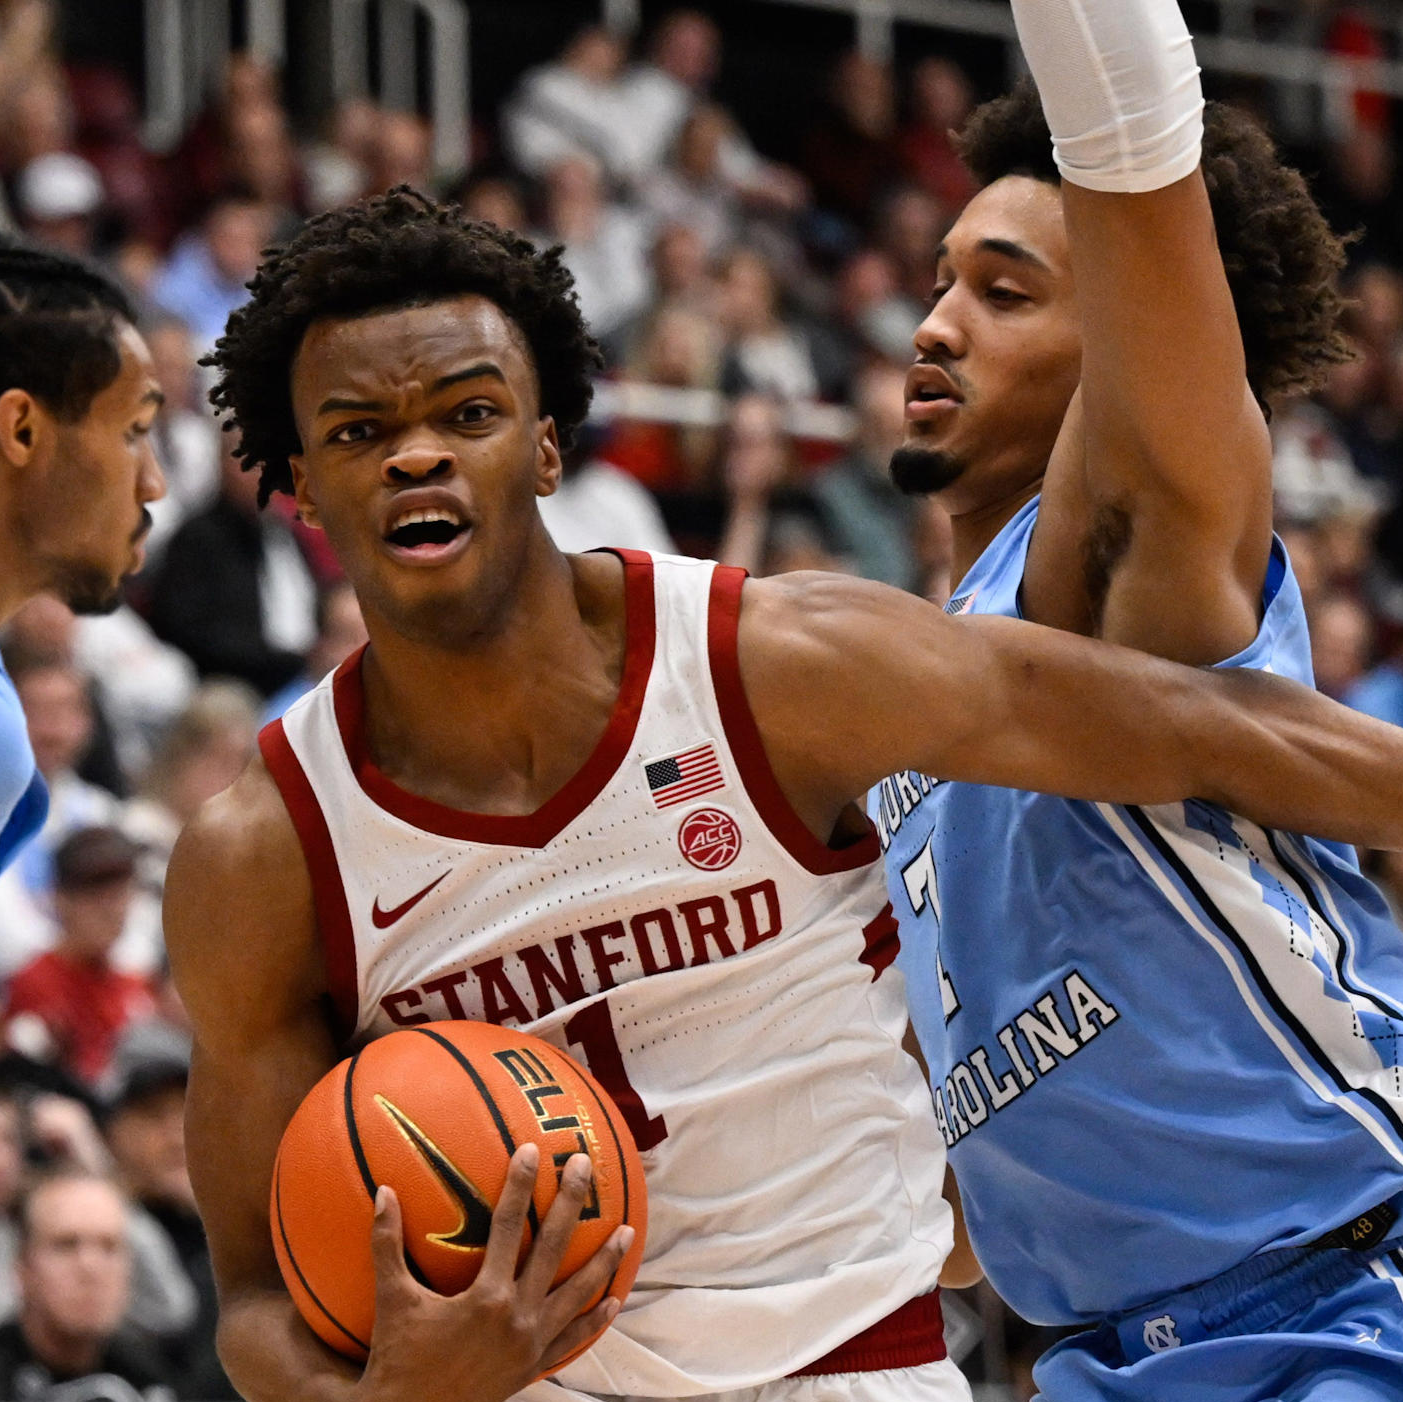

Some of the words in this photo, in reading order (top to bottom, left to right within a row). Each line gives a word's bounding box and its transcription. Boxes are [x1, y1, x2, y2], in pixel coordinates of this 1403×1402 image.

[690, 822, 732, 850] ACC
[379, 878, 783, 1027] STANFORD
[564, 997, 669, 1152] 1
[933, 968, 1121, 1149] AROLINA
[1352, 1217, 1373, 1241] 48
